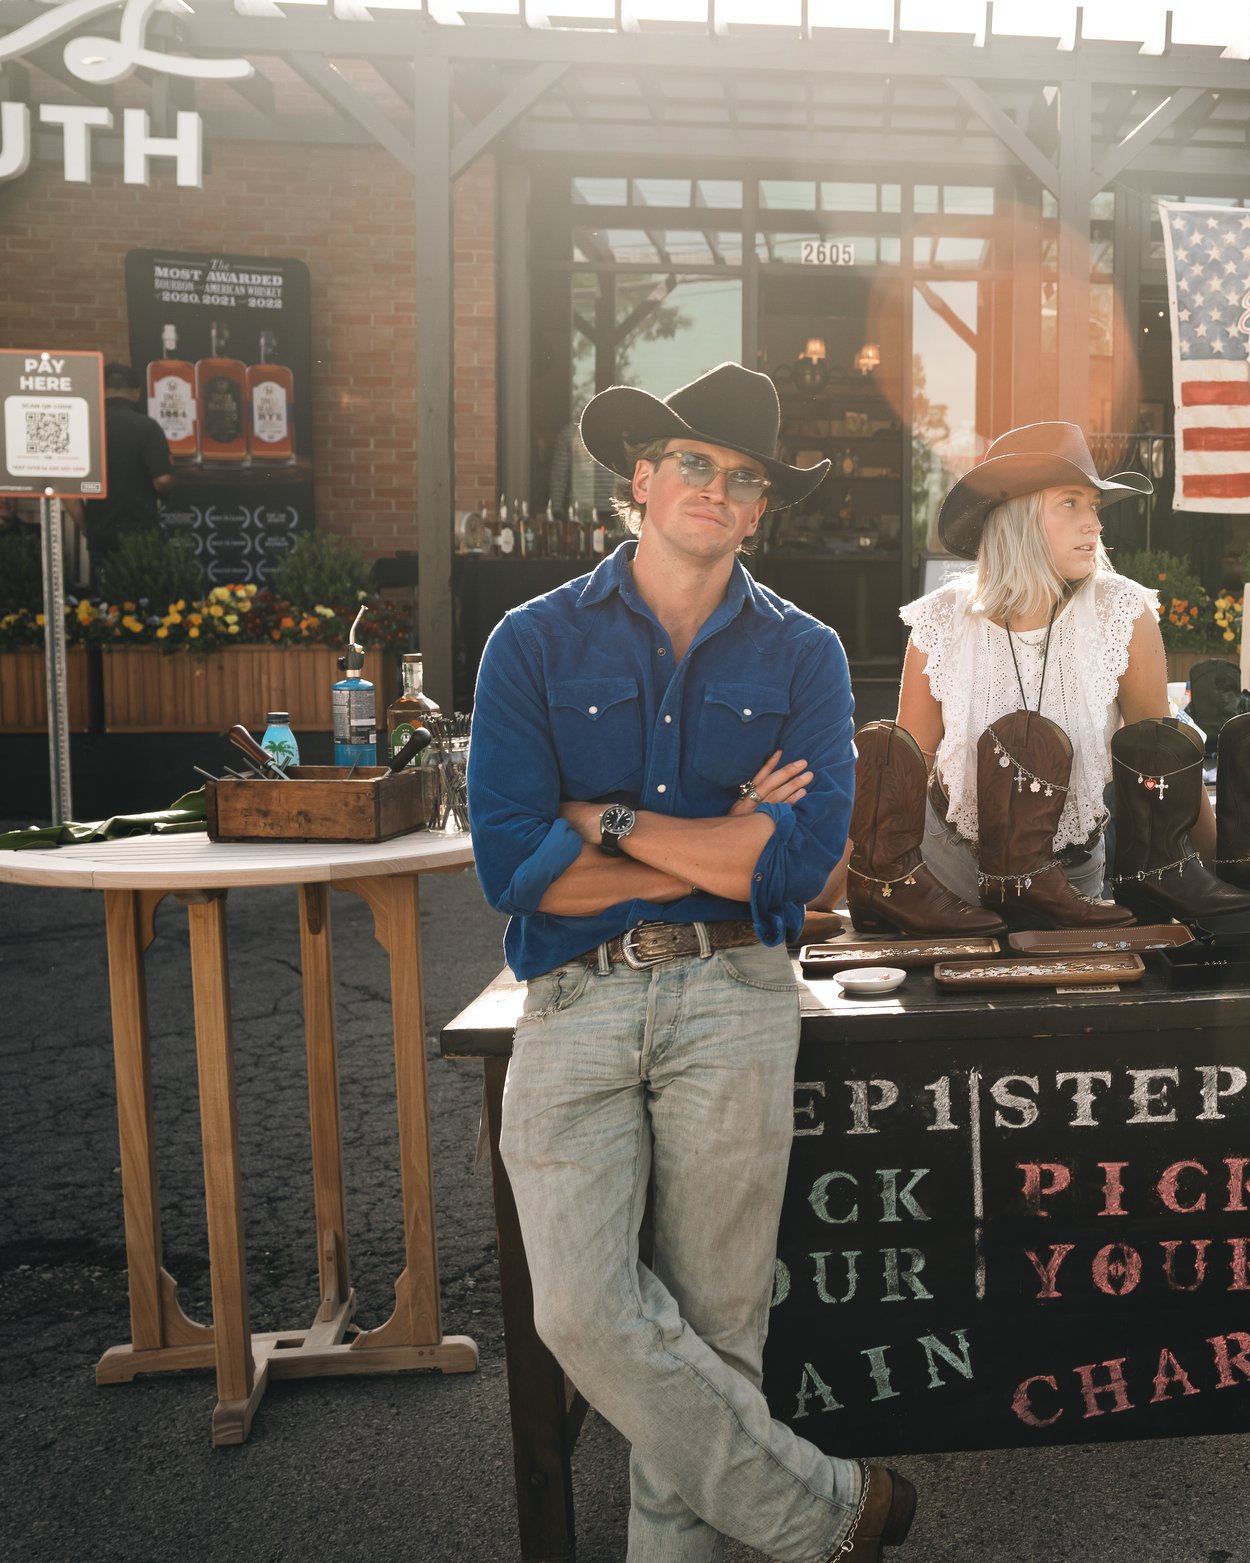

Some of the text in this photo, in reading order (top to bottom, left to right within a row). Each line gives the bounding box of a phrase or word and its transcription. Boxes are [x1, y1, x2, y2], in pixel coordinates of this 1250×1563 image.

[803, 243, 852, 264] 2605
[211, 259, 230, 271] The
[154, 266, 283, 286] MOST AWARDED
[154, 278, 194, 291] BOURBON
[204, 283, 245, 296] AMERICAN
[247, 286, 282, 297] WHISKEY
[202, 295, 236, 306] 2021
[248, 297, 283, 309] 2022
[24, 358, 65, 374] PAY
[20, 375, 72, 391] HERE
[807, 1168, 932, 1224] CK
[792, 1328, 974, 1419] AIN
